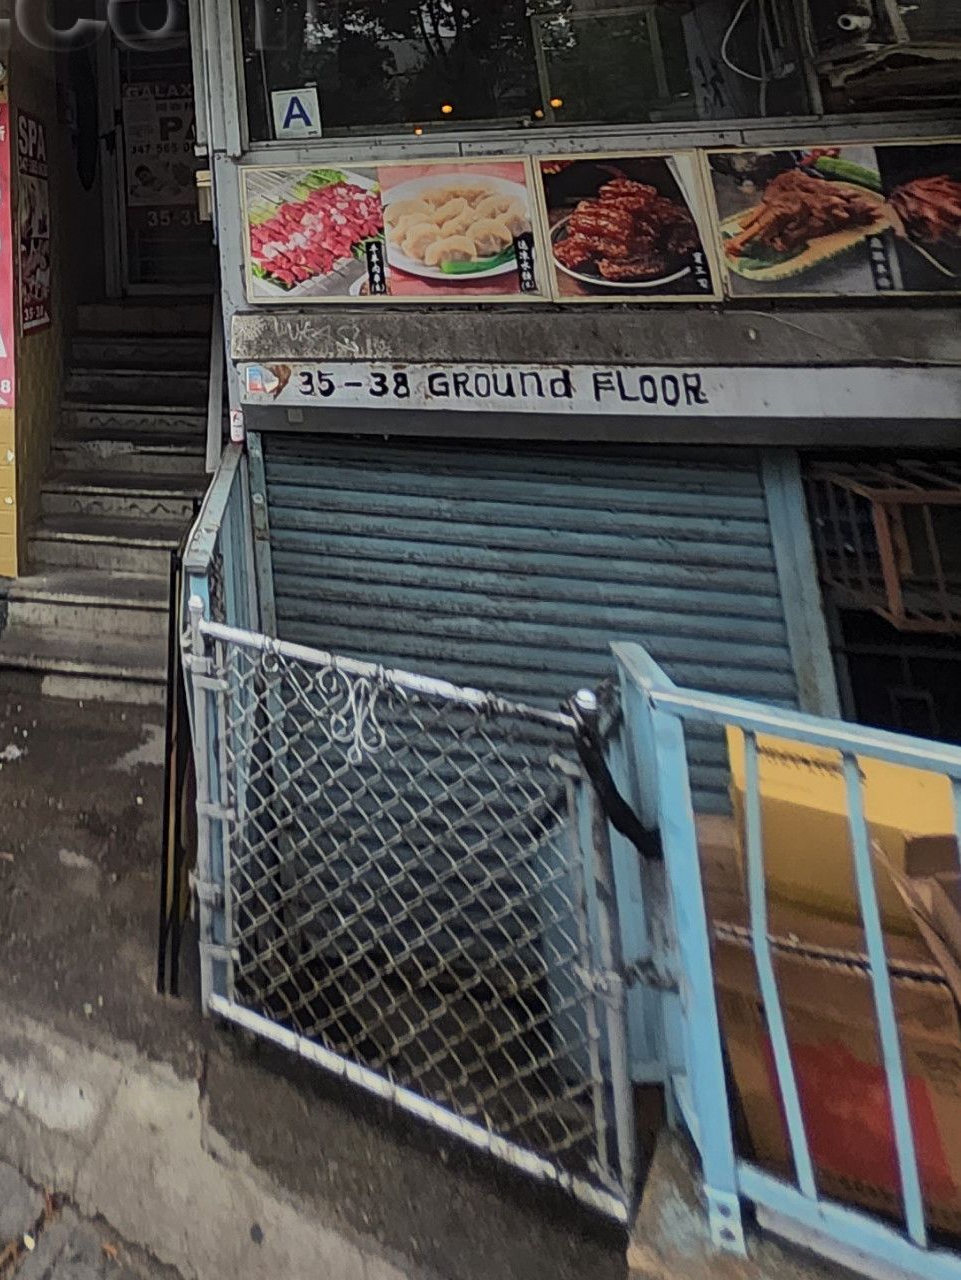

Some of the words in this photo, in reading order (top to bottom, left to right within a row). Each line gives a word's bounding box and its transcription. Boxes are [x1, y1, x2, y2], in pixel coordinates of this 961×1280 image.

[283, 96, 313, 129] A
[18, 115, 47, 162] SPA
[298, 370, 411, 399] 35-38
[592, 371, 709, 407] FLOOR
